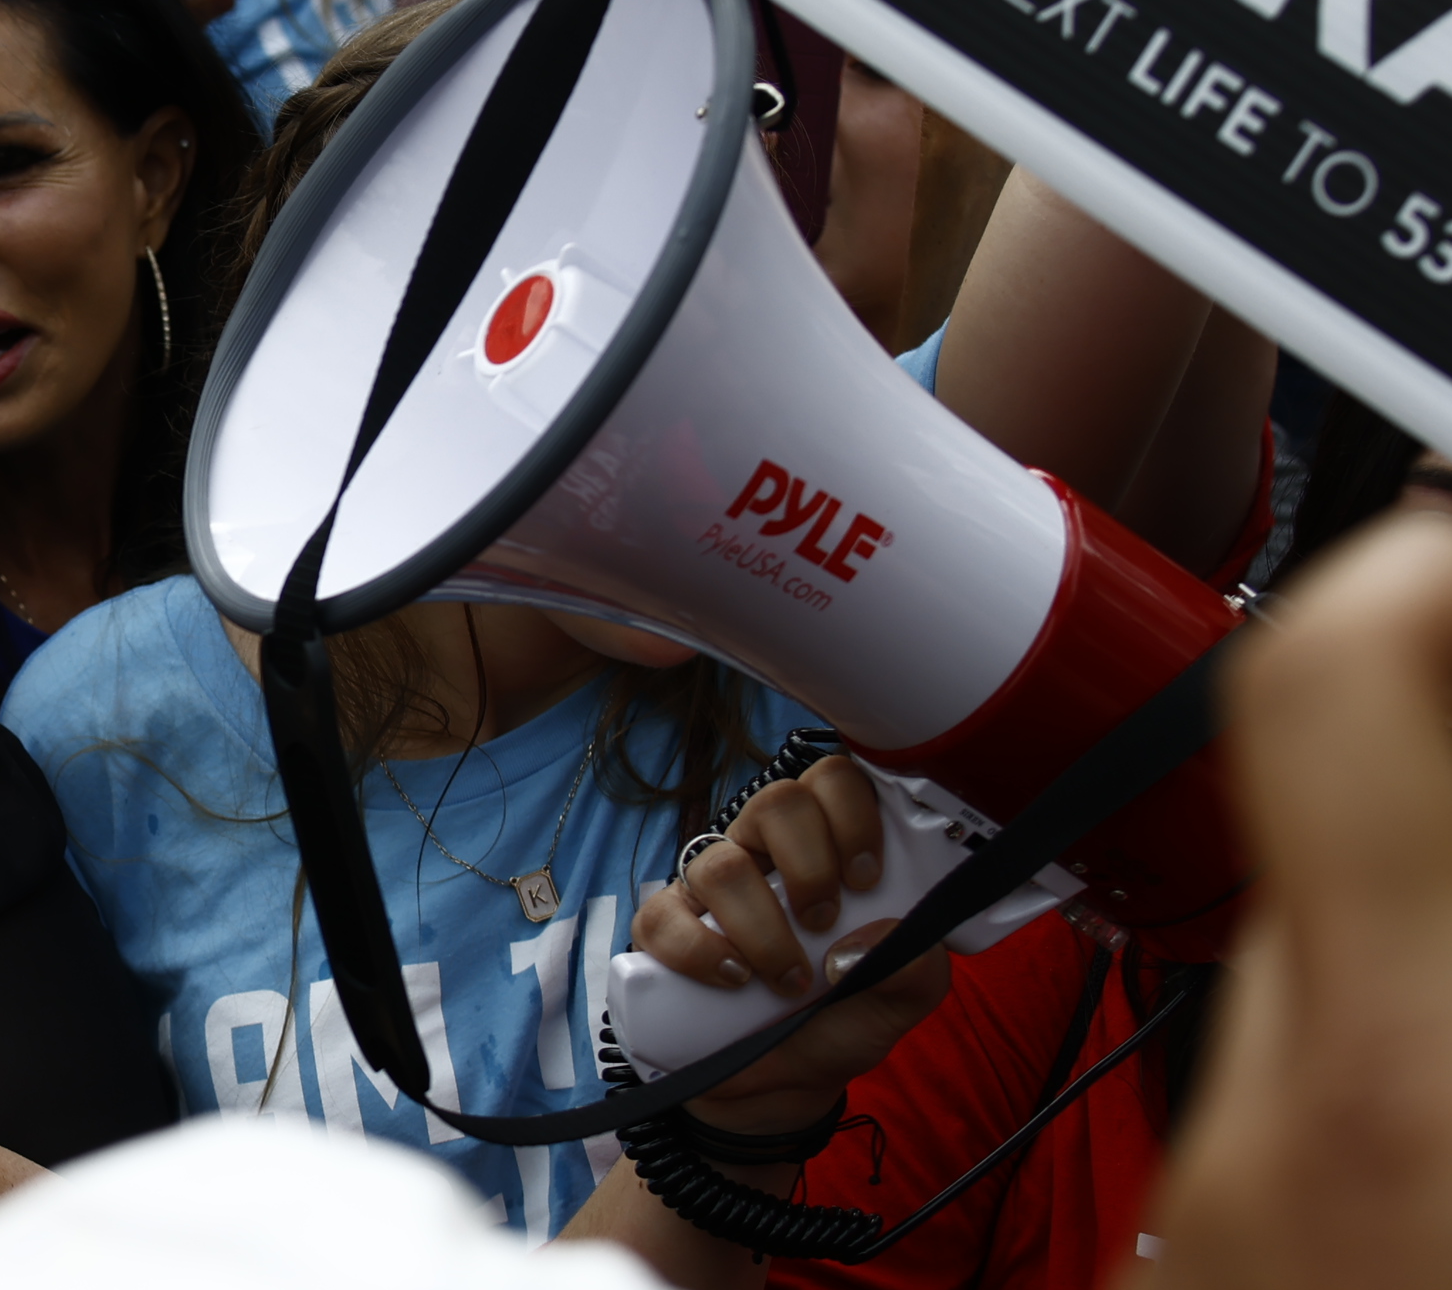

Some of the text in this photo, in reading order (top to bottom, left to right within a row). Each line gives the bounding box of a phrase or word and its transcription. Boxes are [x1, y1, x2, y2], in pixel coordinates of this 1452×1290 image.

[1126, 30, 1281, 157] LIFE
[1284, 121, 1379, 218] TO
[698, 522, 833, 611] PyleUSA.com
